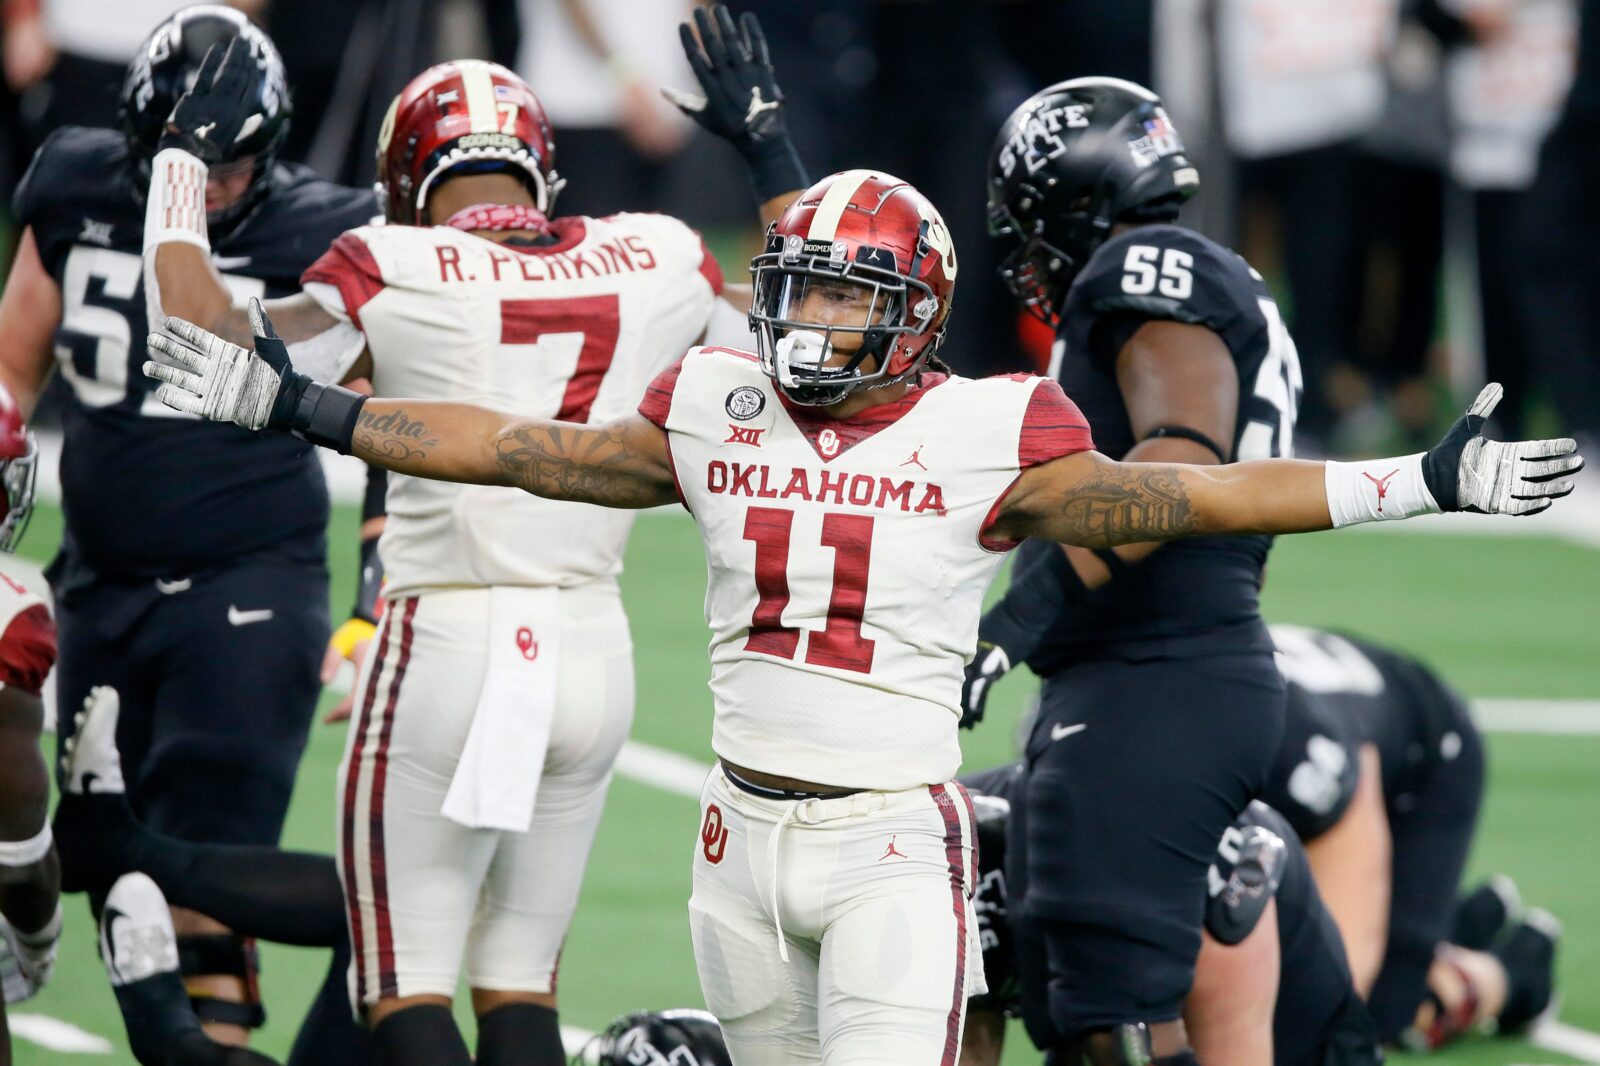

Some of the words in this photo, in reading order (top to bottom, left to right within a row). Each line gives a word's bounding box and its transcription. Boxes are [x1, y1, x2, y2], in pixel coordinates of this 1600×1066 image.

[497, 102, 519, 134] 7
[1000, 104, 1089, 178] STATE
[434, 244, 476, 282] R.
[488, 234, 658, 282] PERKINS
[804, 244, 832, 253] BOOMER
[1121, 246, 1194, 299] 55
[500, 294, 620, 424] 7
[818, 429, 840, 456] OU
[707, 460, 948, 516] OKLAHOMA
[742, 506, 875, 674] 11
[516, 627, 538, 662] OU
[702, 804, 728, 864] OU
